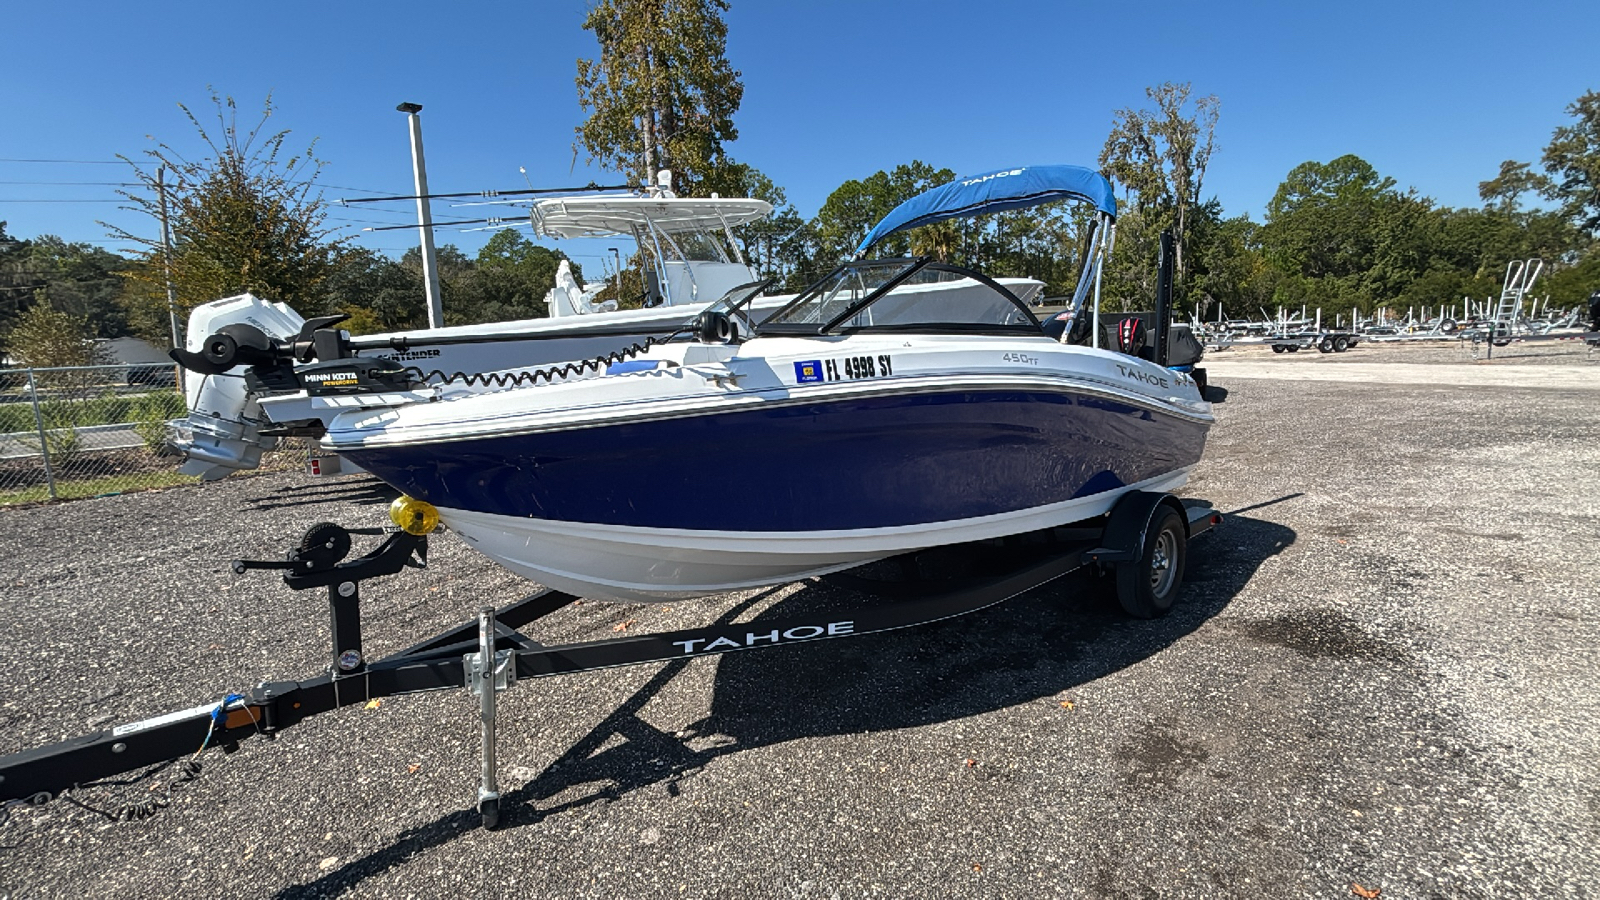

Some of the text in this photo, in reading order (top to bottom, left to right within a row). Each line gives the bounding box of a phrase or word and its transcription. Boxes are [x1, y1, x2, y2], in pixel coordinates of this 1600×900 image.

[962, 169, 1023, 187] TAHOE
[304, 372, 358, 383] MINN KOTA
[825, 354, 893, 381] FL 4998 SY
[1116, 364, 1169, 389] TAHOE
[672, 620, 854, 654] TAHOE
